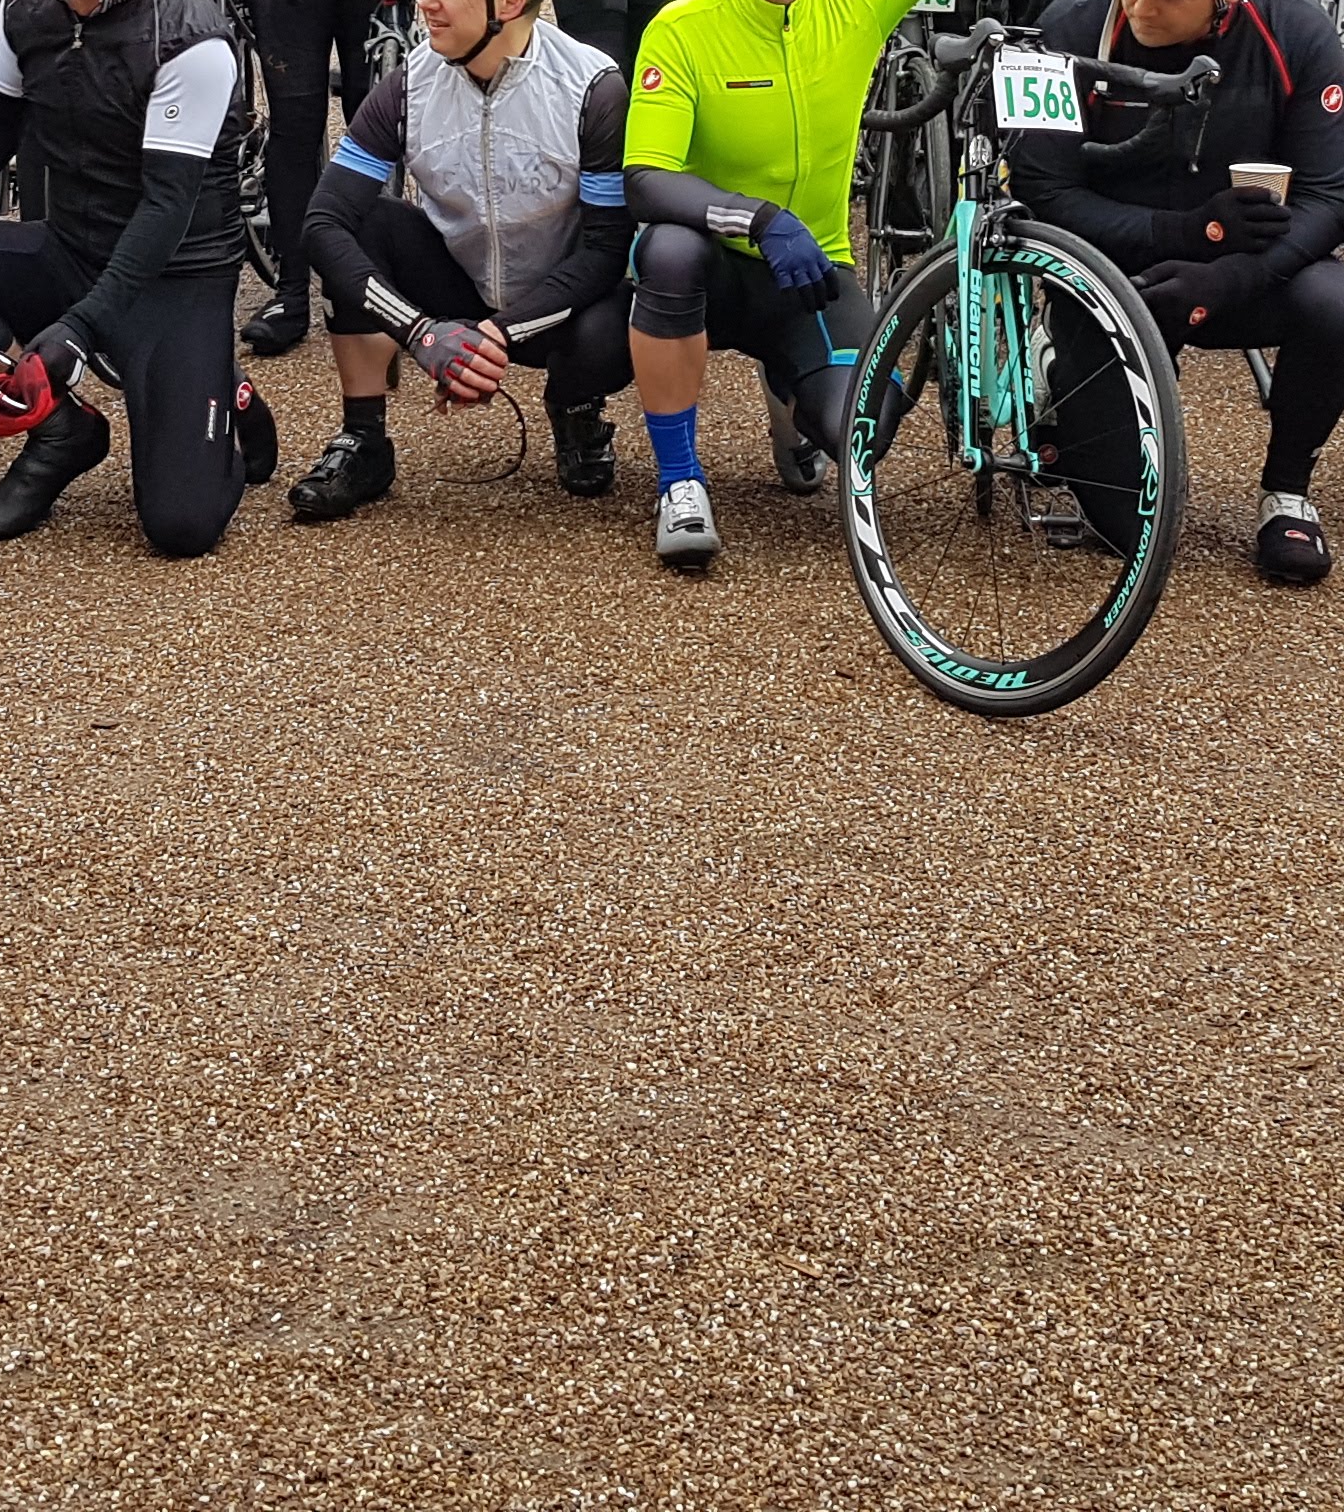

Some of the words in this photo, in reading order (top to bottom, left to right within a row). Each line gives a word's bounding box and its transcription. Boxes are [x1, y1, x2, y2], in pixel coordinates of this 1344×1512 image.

[1003, 76, 1077, 120] 1568
[856, 313, 901, 414] BONTRAGER
[1102, 519, 1153, 629] BONTRAGER
